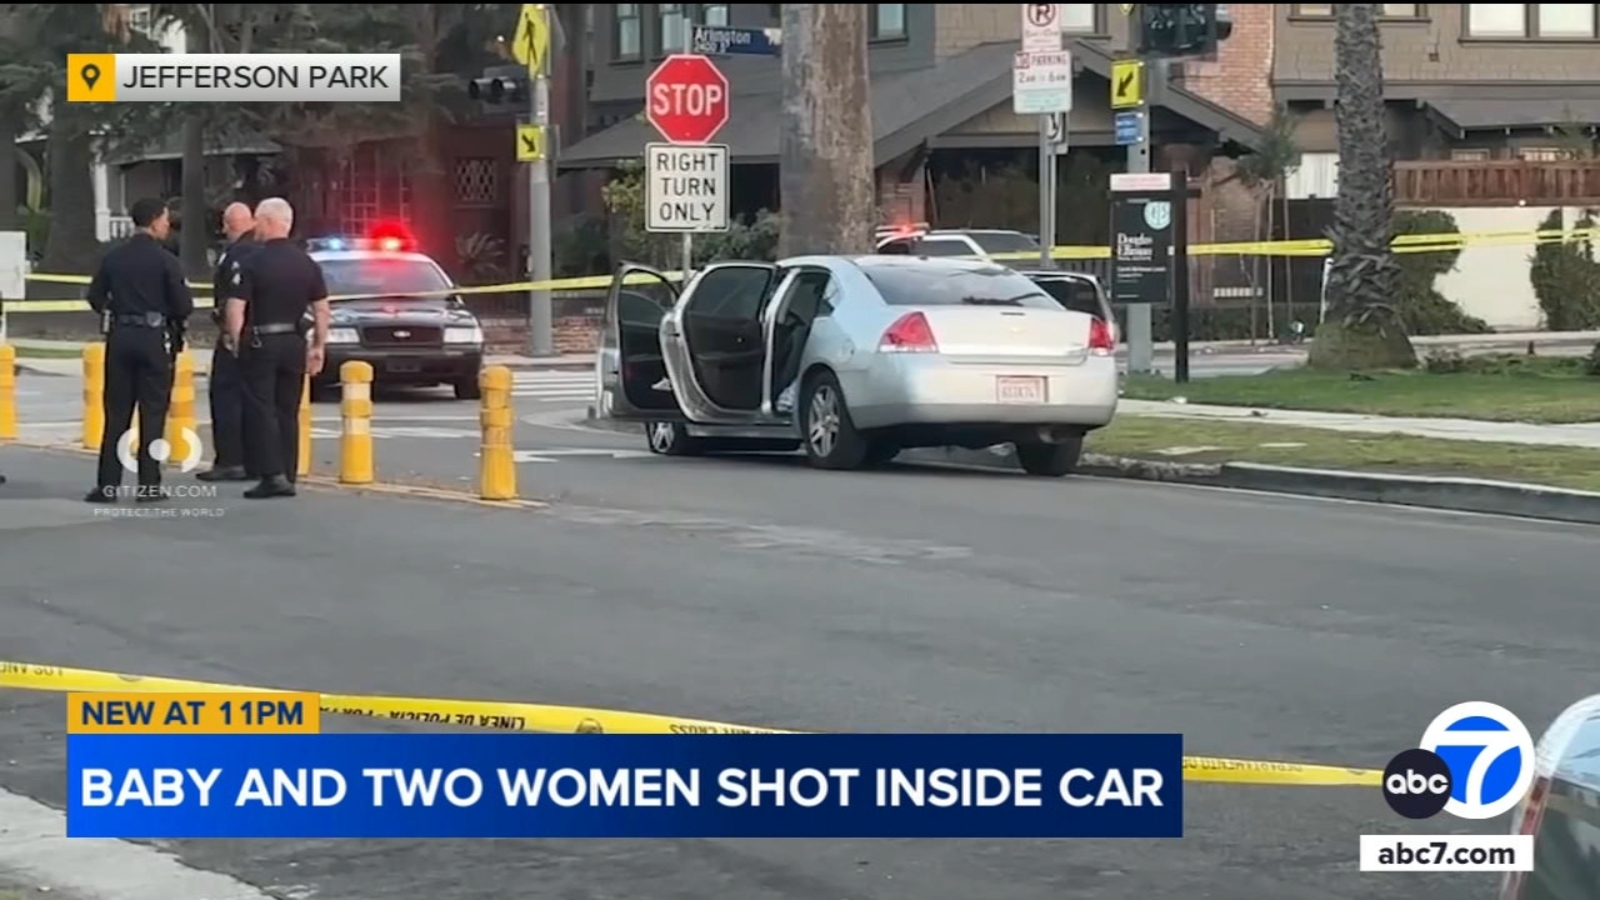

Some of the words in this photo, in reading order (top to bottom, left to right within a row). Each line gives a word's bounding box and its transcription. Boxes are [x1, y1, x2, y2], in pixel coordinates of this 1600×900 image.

[694, 27, 751, 48] Arlington
[1031, 54, 1067, 66] PARKING
[653, 83, 722, 116] STOP
[657, 153, 719, 171] RIGHT
[661, 177, 716, 196] TURN
[660, 202, 716, 221] ONLY
